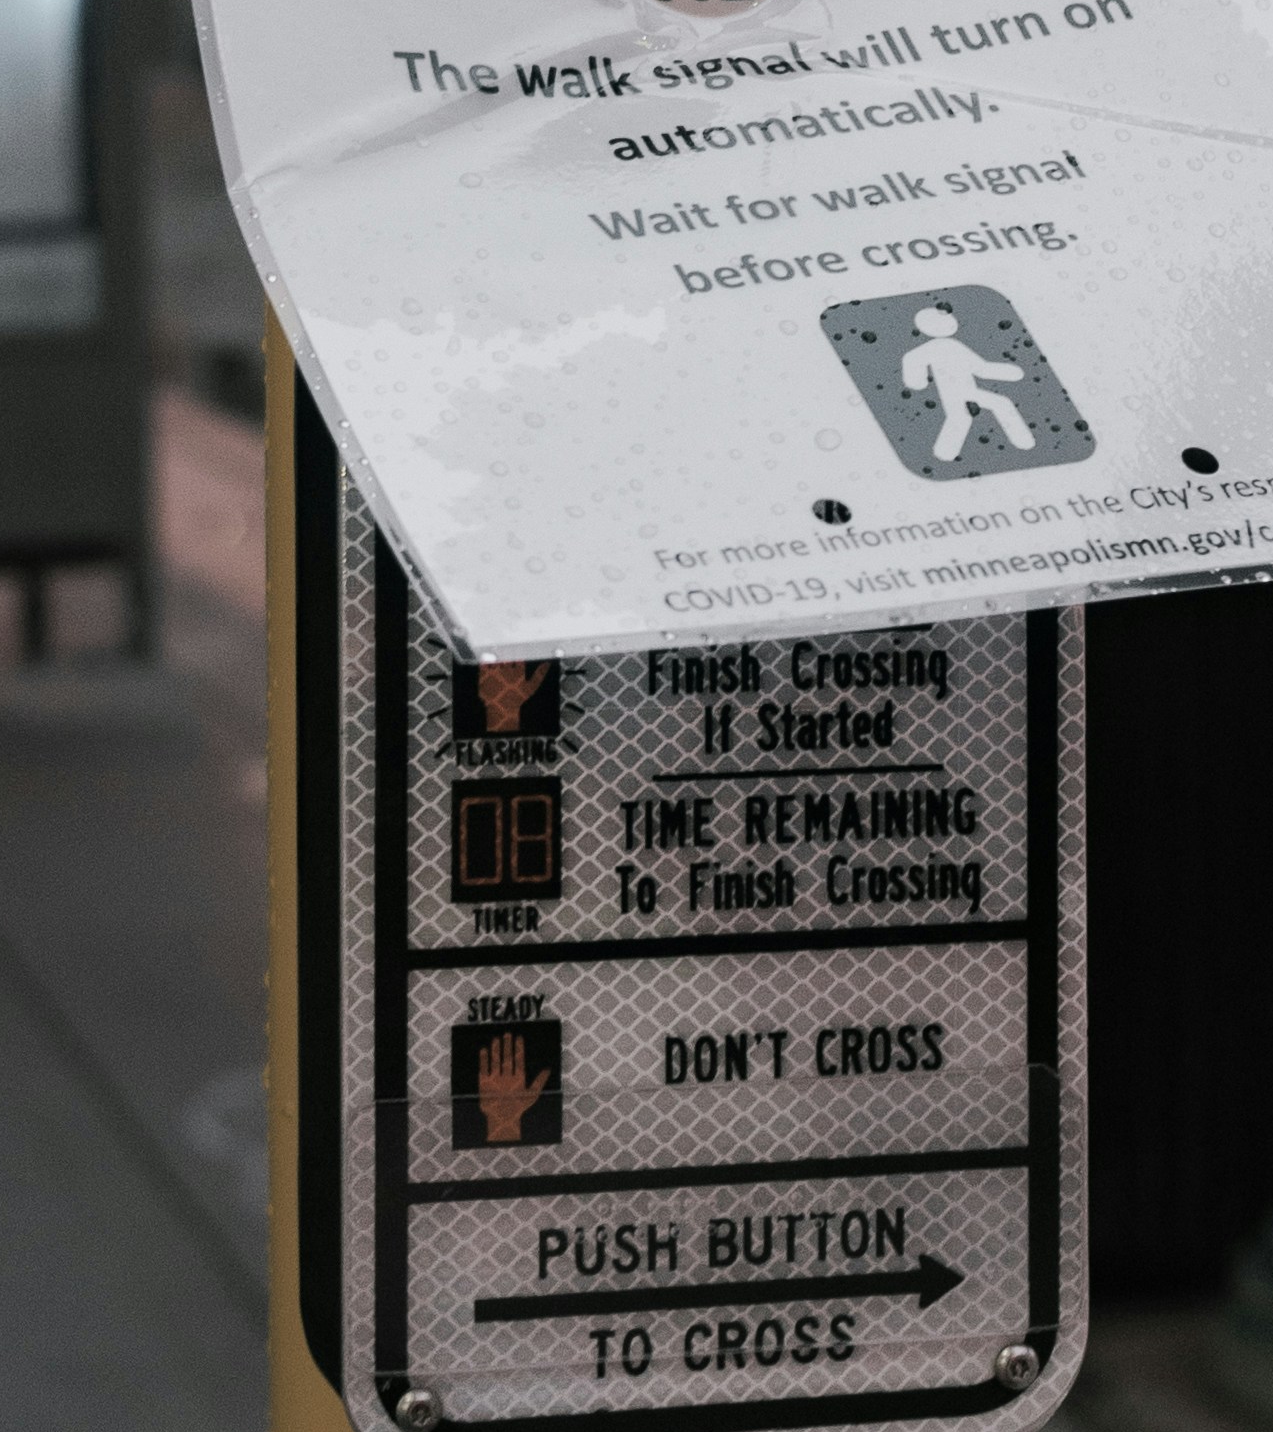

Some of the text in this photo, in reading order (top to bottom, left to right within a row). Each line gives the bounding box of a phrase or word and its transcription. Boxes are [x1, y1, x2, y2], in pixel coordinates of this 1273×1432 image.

[393, 49, 499, 94] The
[515, 55, 642, 98] walk
[653, 41, 813, 90] signal
[821, 26, 923, 69] will
[930, 10, 1051, 55] turn
[608, 87, 1000, 161] automatically.
[588, 150, 1087, 241] Wait for walk signal
[673, 220, 1079, 295] before crossing.
[653, 548, 709, 571] For
[721, 538, 810, 565] more
[818, 506, 1013, 554] information
[1020, 501, 1062, 526] on
[1066, 494, 1124, 518] the
[1129, 480, 1214, 512] City's
[663, 576, 842, 613] COVID-19,
[845, 567, 917, 595] visit
[648, 638, 949, 701] Finish Crossing
[455, 739, 559, 766] FLASHING
[757, 699, 894, 752] Started
[620, 786, 978, 850] TIME REMAINING
[616, 853, 981, 915] To Finish Crossing
[473, 906, 540, 934] TIMER
[467, 994, 546, 1023] STEADY
[665, 1022, 944, 1084] DON'T CROSS
[538, 1207, 906, 1280] PUSH BUTTON
[590, 1313, 856, 1379] TO CROSS
